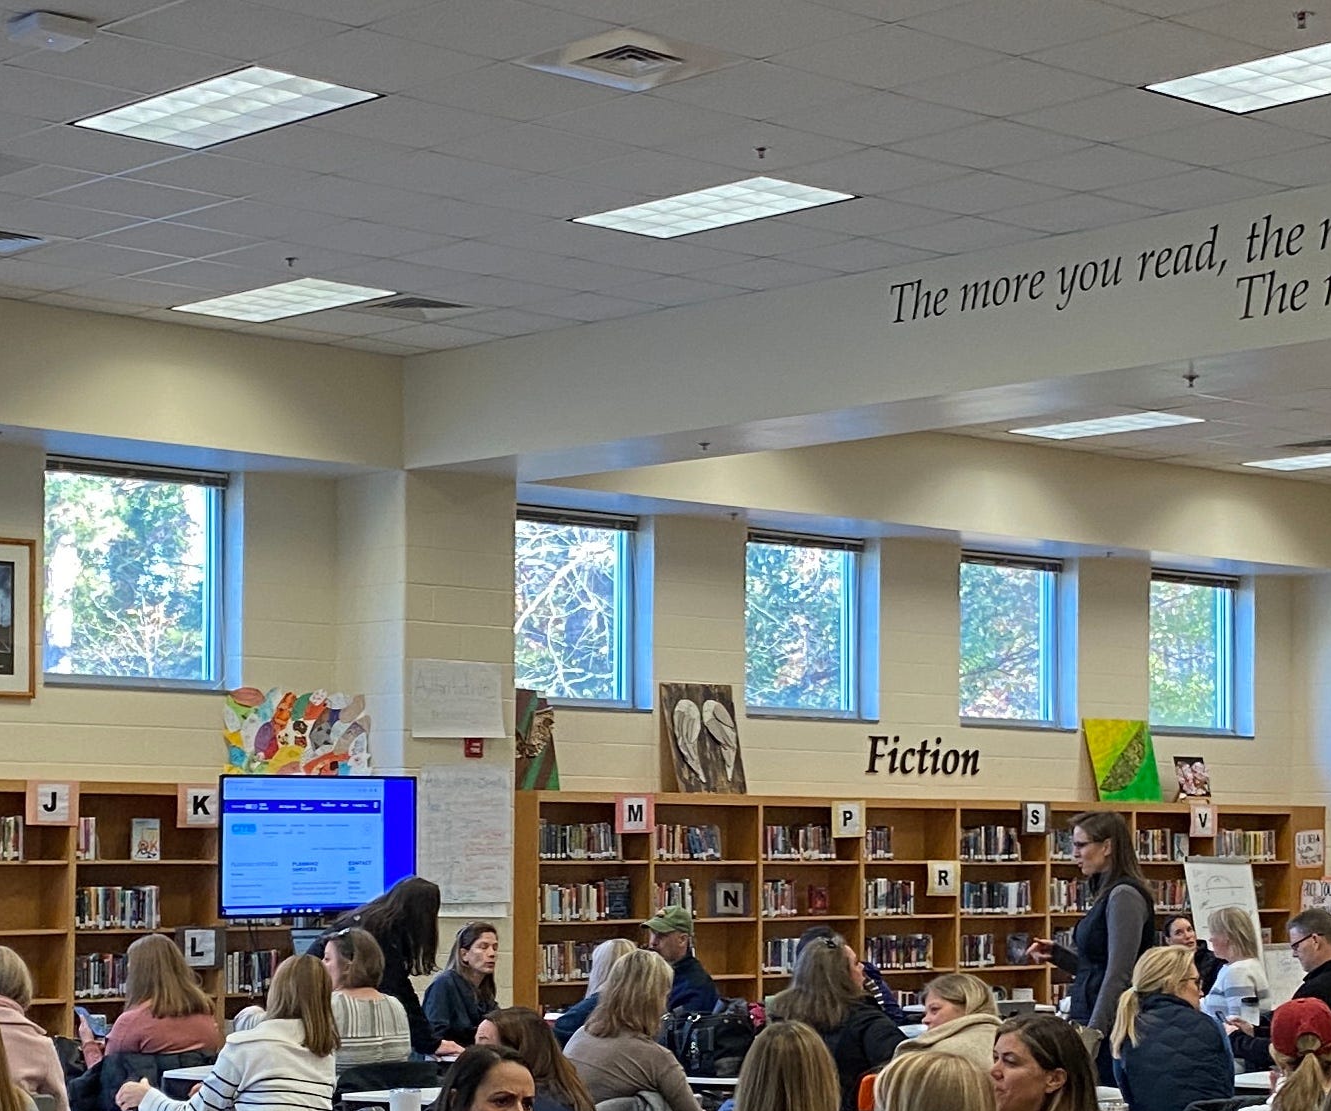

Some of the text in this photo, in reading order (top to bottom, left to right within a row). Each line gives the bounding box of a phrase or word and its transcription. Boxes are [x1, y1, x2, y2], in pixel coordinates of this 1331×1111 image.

[889, 279, 949, 324] The
[959, 269, 1046, 312] more
[1055, 256, 1123, 311] you
[1137, 224, 1228, 278] read,
[1245, 214, 1306, 264] the
[1236, 270, 1310, 321] The
[864, 735, 981, 776] Fiction
[42, 791, 58, 813] J
[192, 794, 211, 815] K
[627, 804, 643, 822] M
[842, 810, 853, 827] P
[1030, 809, 1040, 826] S
[1198, 813, 1208, 828] V
[938, 870, 949, 886] R
[723, 890, 740, 908] N
[190, 937, 205, 957] L
